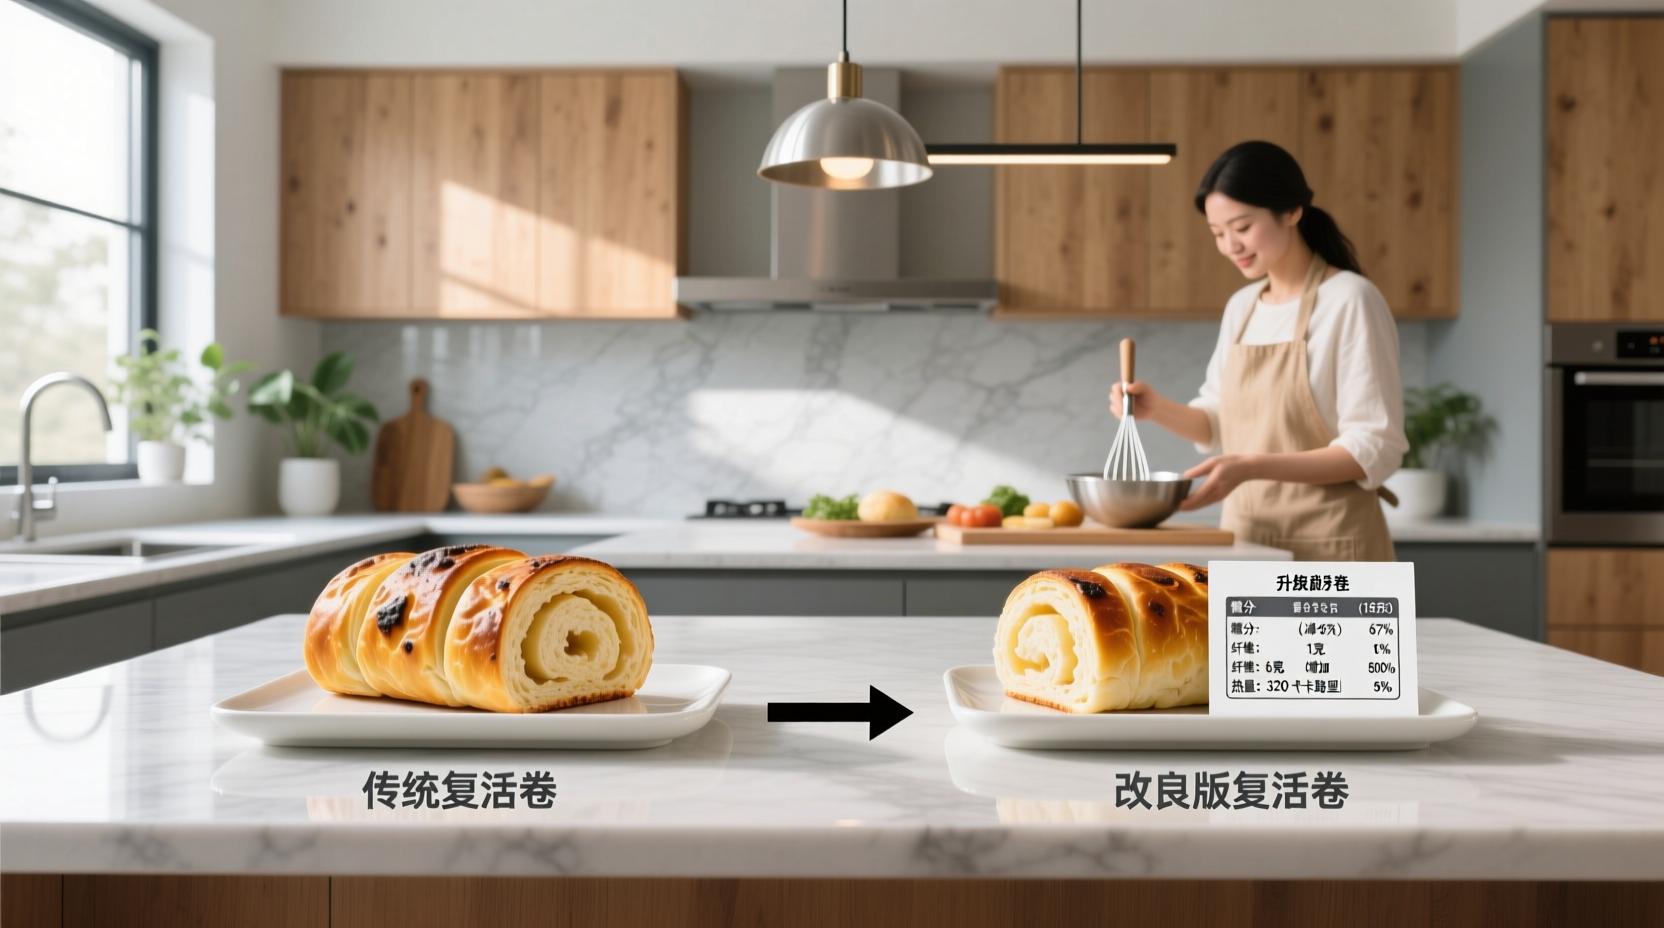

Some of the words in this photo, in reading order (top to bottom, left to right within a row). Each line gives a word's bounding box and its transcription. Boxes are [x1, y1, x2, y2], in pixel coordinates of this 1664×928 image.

[1369, 623, 1394, 636] 67%
[1368, 661, 1396, 674] 500%
[1266, 680, 1289, 692] 320
[1373, 681, 1392, 693] 5%
